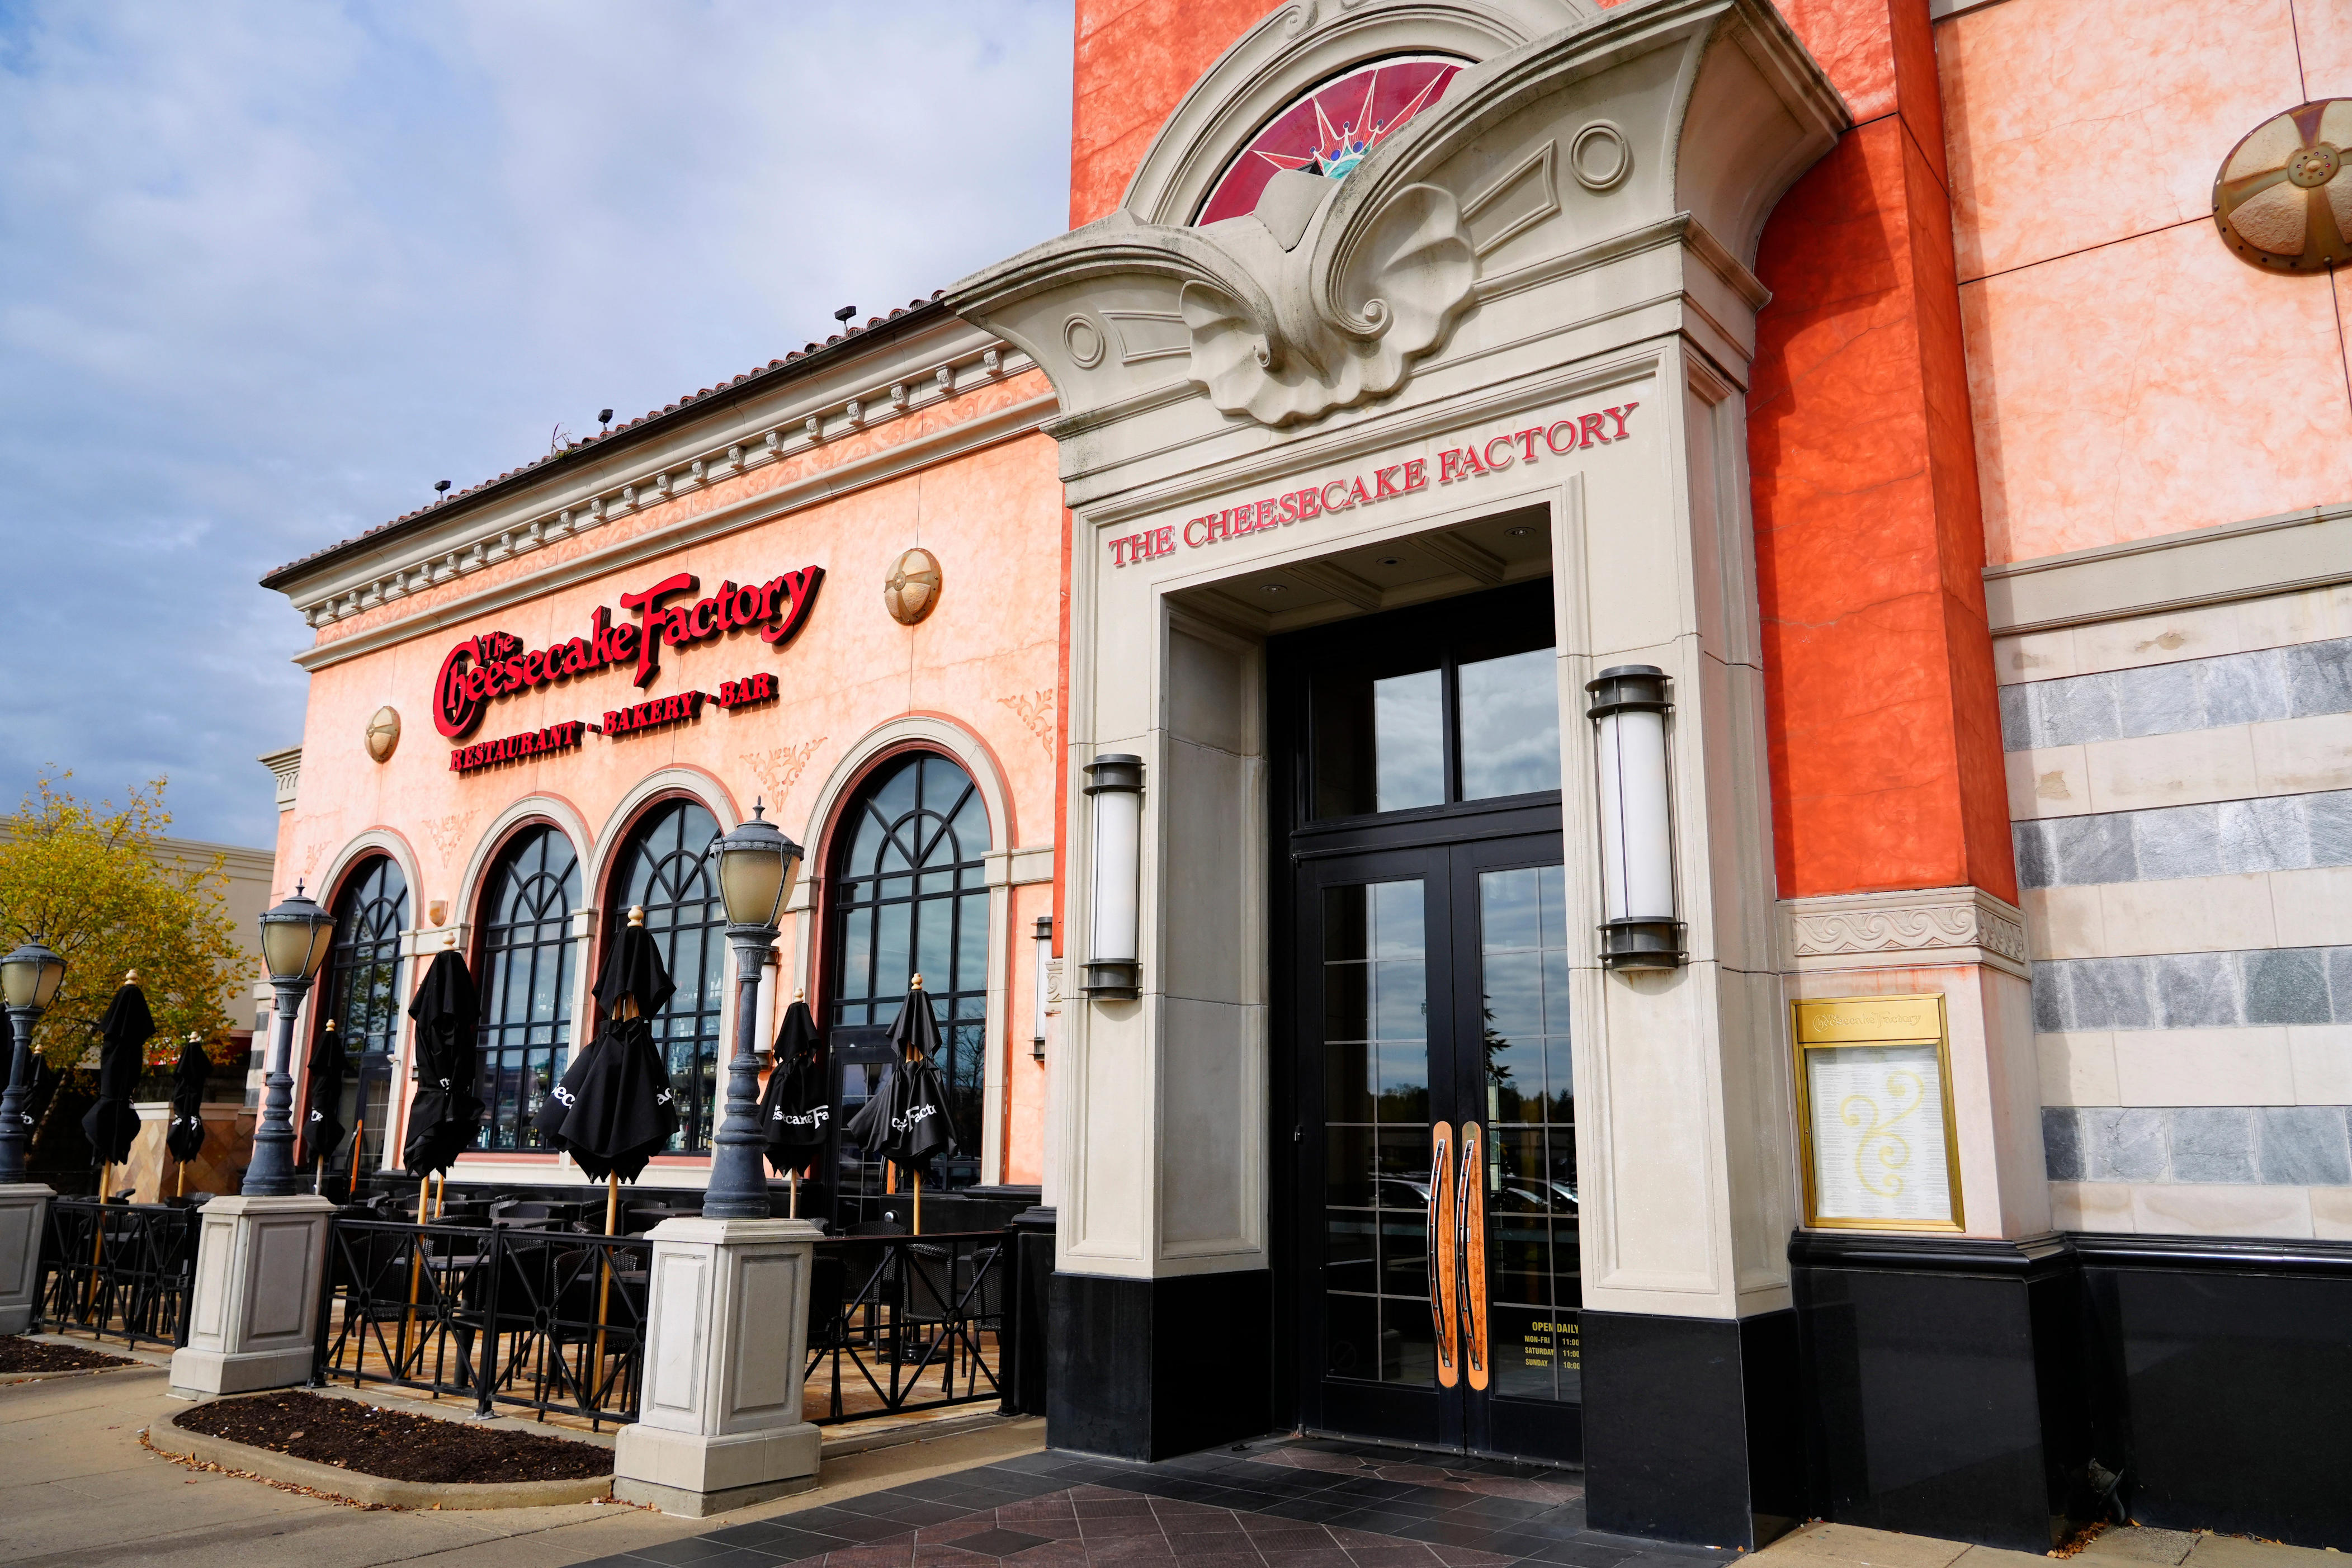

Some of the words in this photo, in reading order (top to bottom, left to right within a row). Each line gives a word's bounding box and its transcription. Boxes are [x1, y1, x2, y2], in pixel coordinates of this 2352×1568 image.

[1108, 524, 1175, 566] THE
[1183, 457, 1428, 548] CHEESECAKE
[1438, 402, 1639, 483] FACTORY
[433, 605, 637, 738] Cheesecake
[620, 565, 819, 687] Factory
[480, 631, 514, 662] The
[449, 720, 578, 772] RESTAURANT
[602, 690, 697, 736] BAKERY
[719, 672, 771, 708] BAR
[1813, 1013, 1875, 1032] Cheesecake
[1872, 1011, 1921, 1028] Factory
[1532, 1321, 1553, 1332] OPEN
[1556, 1323, 1579, 1334] DAILY
[1524, 1335, 1550, 1344] MON-FRI
[1524, 1347, 1554, 1356] SATURDAY
[1525, 1358, 1548, 1367] SUNDAY
